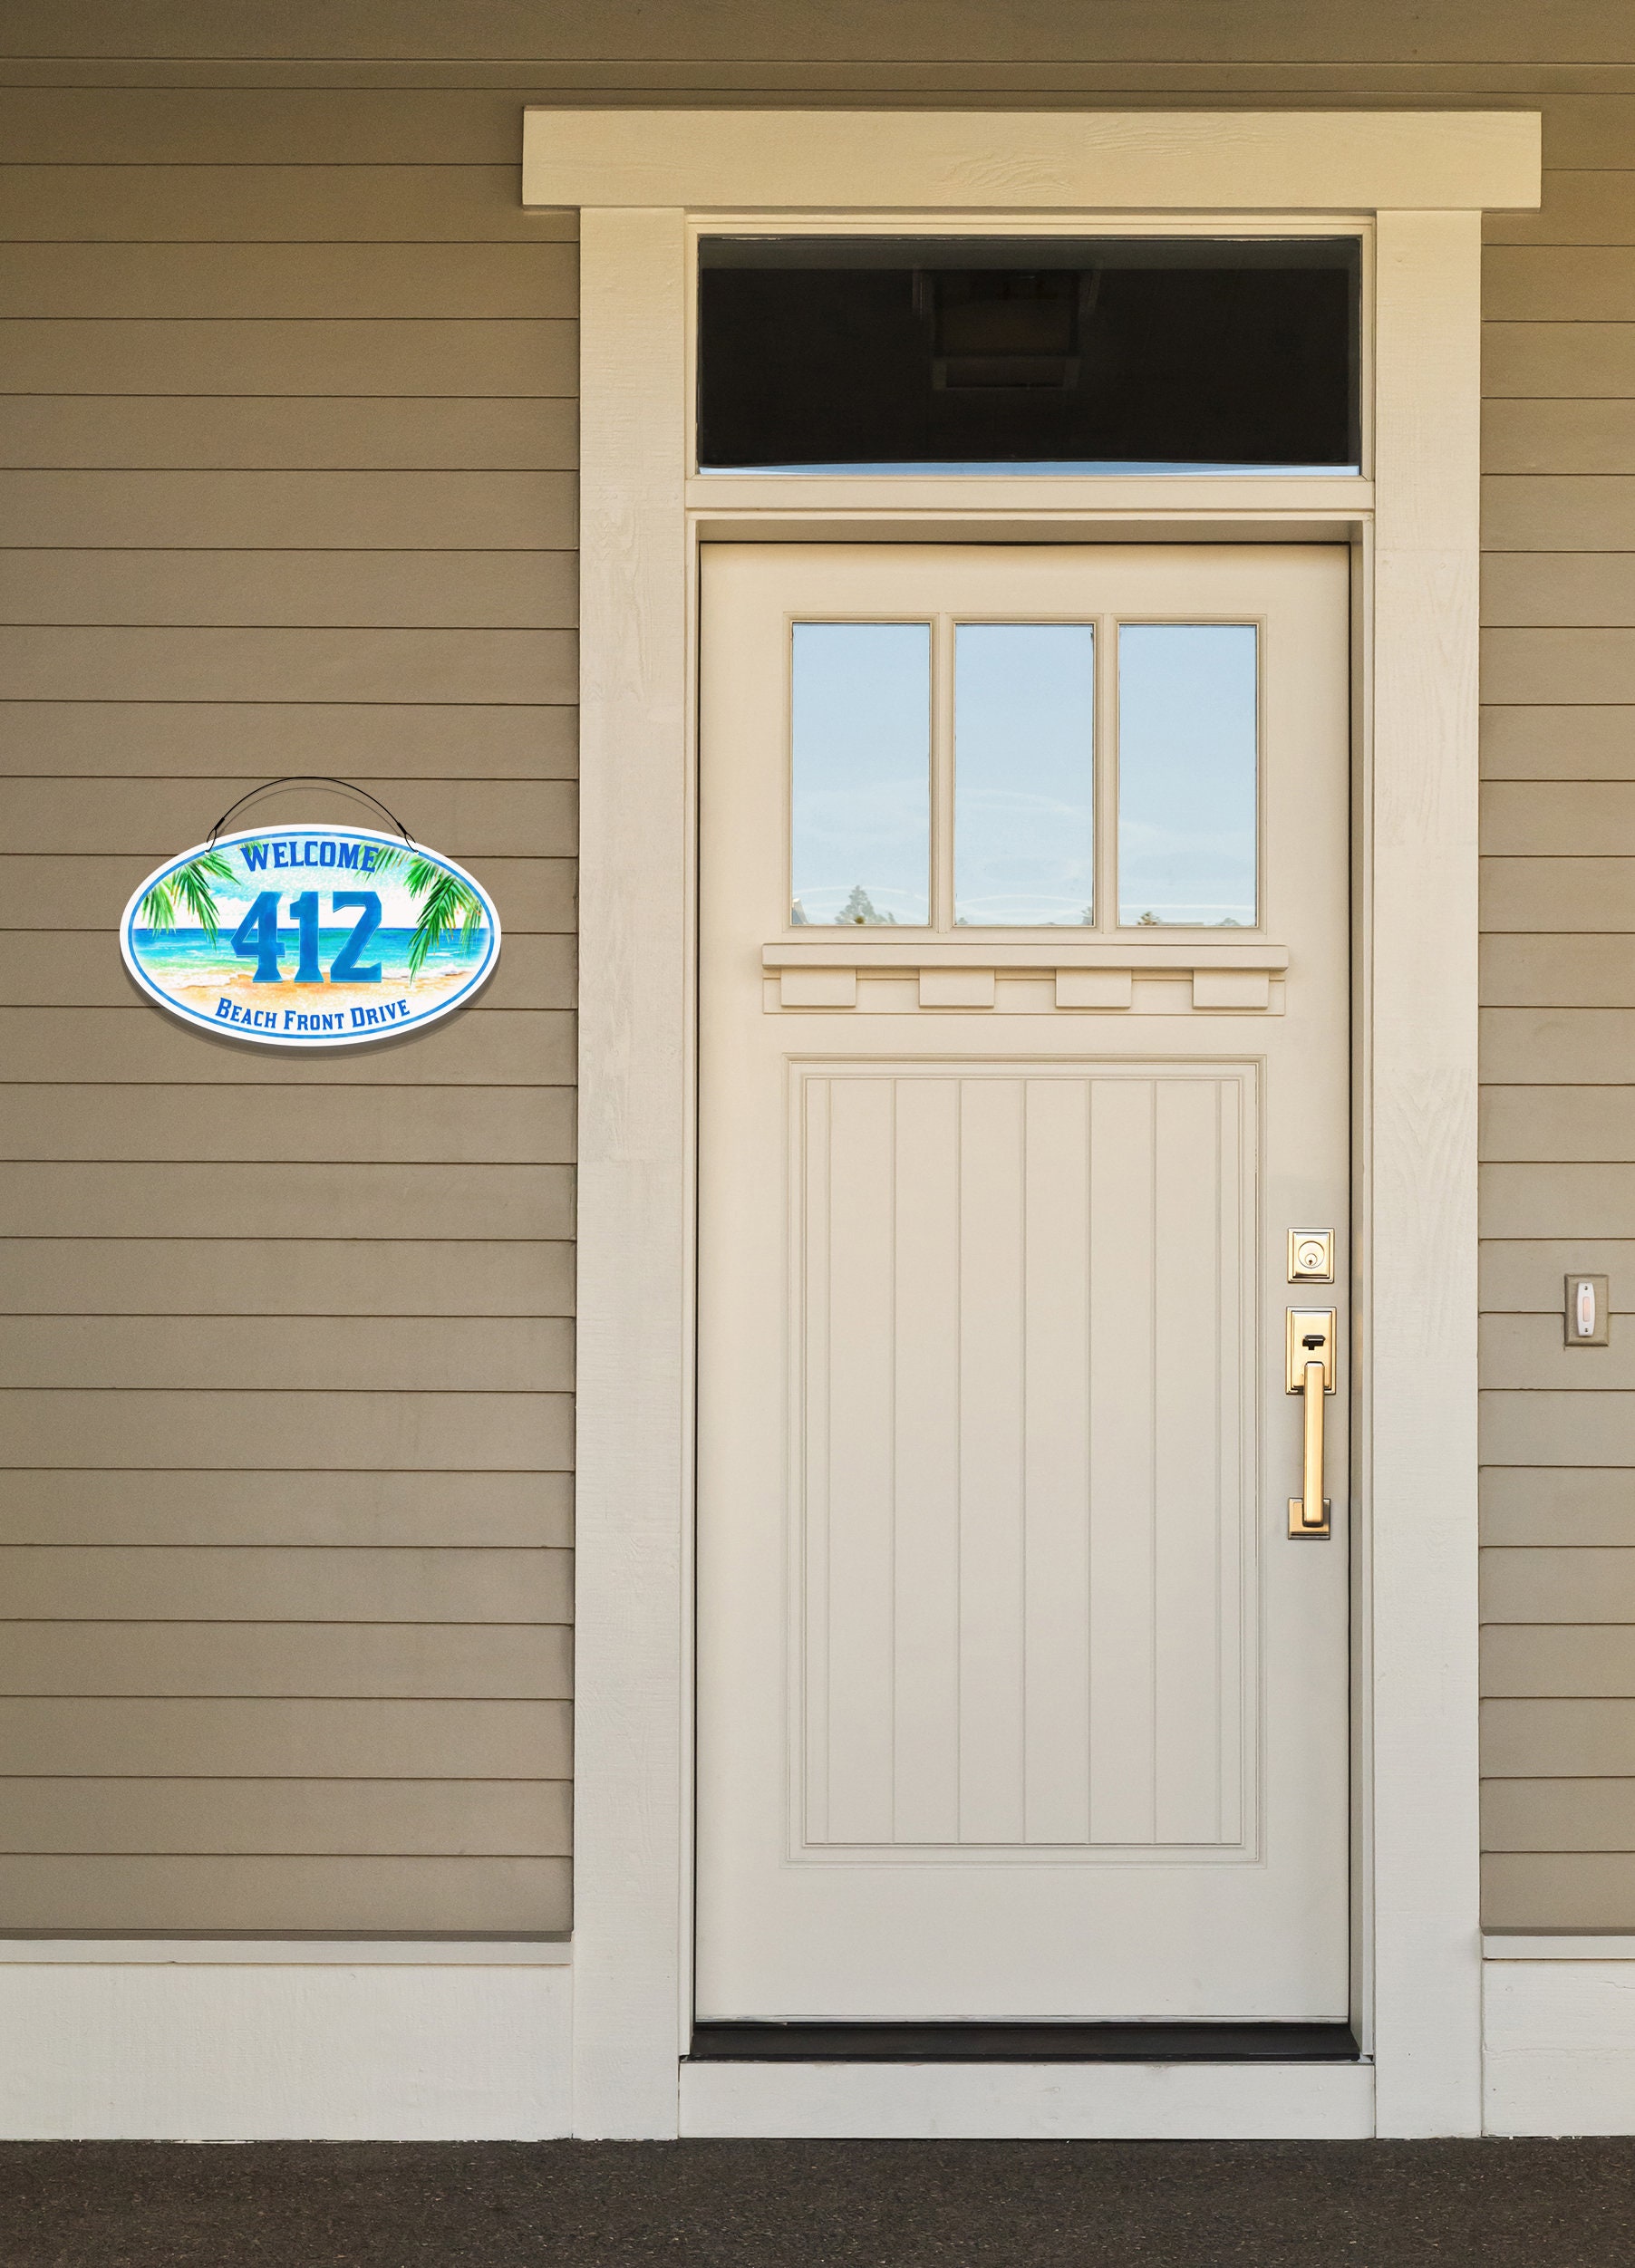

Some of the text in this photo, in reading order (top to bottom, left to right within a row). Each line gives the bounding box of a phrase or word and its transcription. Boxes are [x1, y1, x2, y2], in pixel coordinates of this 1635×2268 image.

[239, 840, 380, 873] WELCOME
[230, 891, 382, 983] 412
[215, 997, 411, 1031] BEACH FRONT DRIVE
